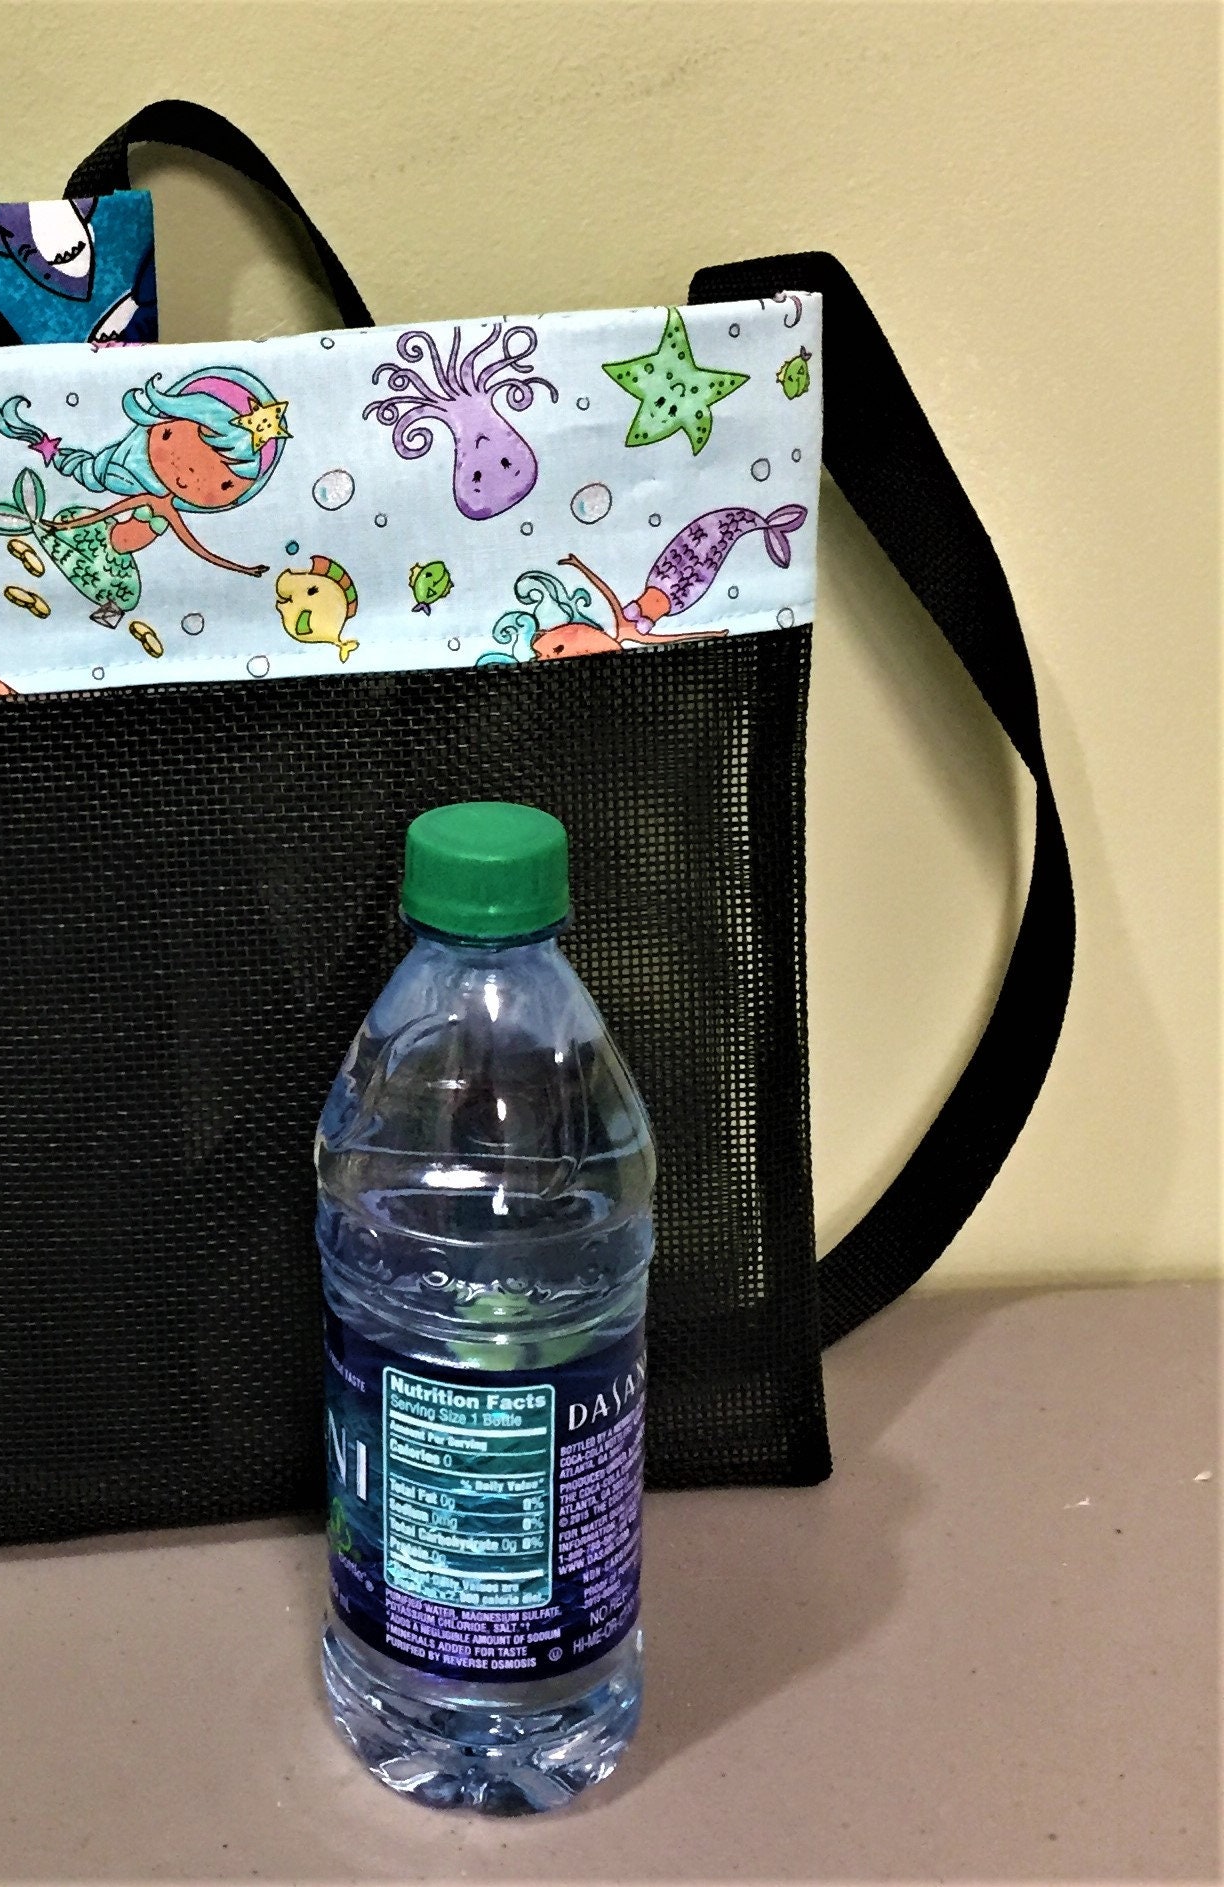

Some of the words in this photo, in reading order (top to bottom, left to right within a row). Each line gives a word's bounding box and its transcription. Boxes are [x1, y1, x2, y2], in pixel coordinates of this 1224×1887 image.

[390, 1374, 480, 1410] Nutrition
[487, 1393, 547, 1411] Facts
[390, 1393, 436, 1422] Serving
[439, 1408, 467, 1426] Size
[471, 1412, 478, 1424] 1
[482, 1412, 523, 1427] Bottle
[389, 1437, 441, 1466] Calories
[443, 1454, 453, 1468] 0
[559, 1443, 604, 1468] COCA-COLA
[560, 1435, 596, 1457] BOTTLED
[389, 1477, 416, 1499] Total
[418, 1488, 438, 1505] Fat
[440, 1494, 456, 1511] 0g
[522, 1495, 545, 1511] 0%
[390, 1516, 416, 1538] Total
[418, 1526, 500, 1551] Carbohydrate
[501, 1538, 518, 1553] 0g
[522, 1537, 545, 1550] 0%
[522, 1517, 545, 1531] 0%
[386, 1598, 436, 1626] POTASSIUM
[461, 1610, 520, 1623] MAGNESIUM
[590, 1605, 608, 1627] NO
[413, 1622, 419, 1632] A
[420, 1623, 471, 1644] NEGLIGIBLE
[472, 1635, 511, 1645] AMOUNT
[513, 1635, 525, 1645] OF
[526, 1627, 561, 1644] SODIUM
[386, 1633, 426, 1659] PURIFIED
[428, 1650, 441, 1661] BY
[442, 1653, 489, 1670] REVERSE
[490, 1657, 537, 1670] OSMOSIS
[437, 1641, 472, 1655] ADDED
[474, 1647, 495, 1657] FOR
[498, 1646, 528, 1657] TASTE
